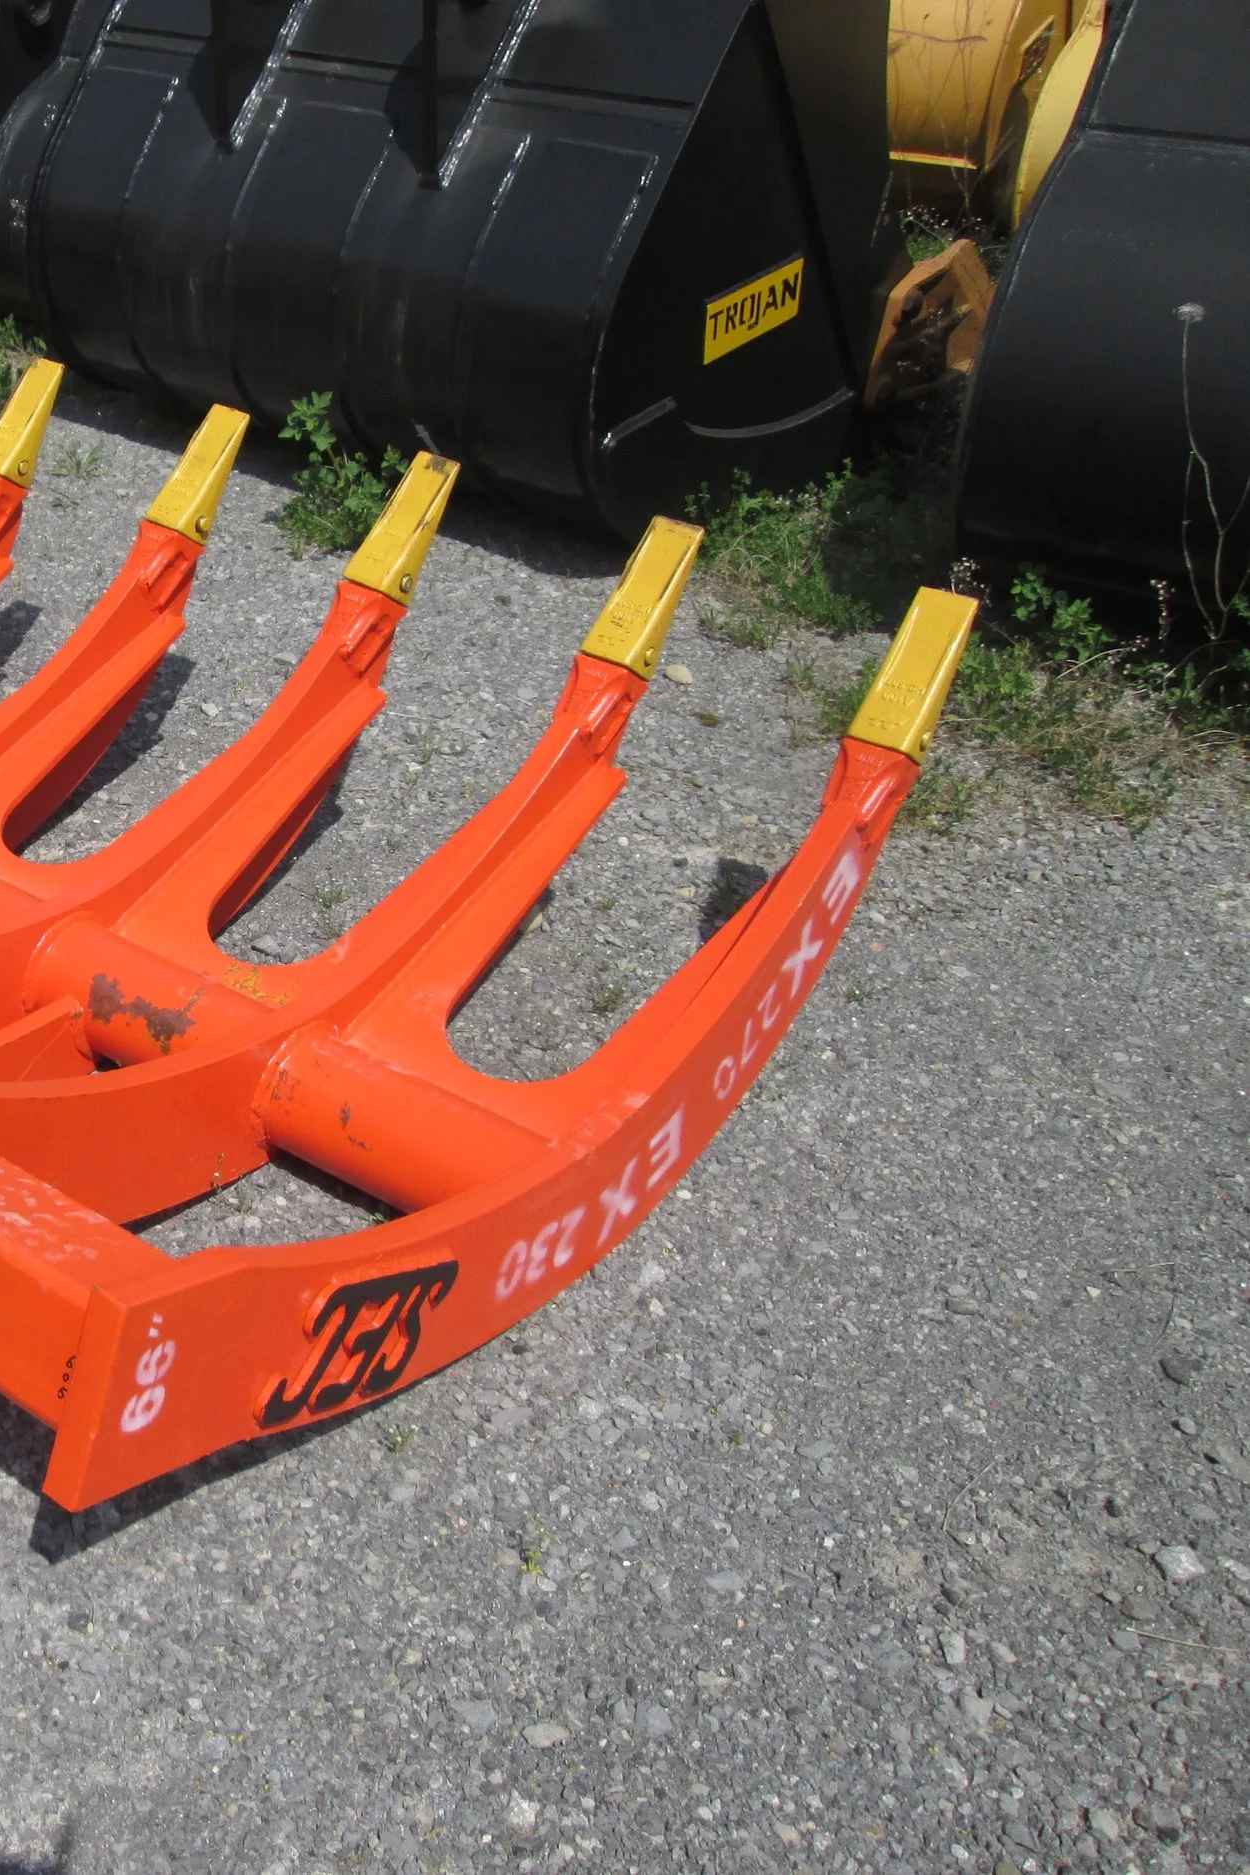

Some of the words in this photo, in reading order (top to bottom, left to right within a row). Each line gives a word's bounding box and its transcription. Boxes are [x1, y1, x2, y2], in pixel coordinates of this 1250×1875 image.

[709, 271, 799, 341] TROJAN
[495, 1205, 586, 1301] 230
[257, 1259, 459, 1426] SEC
